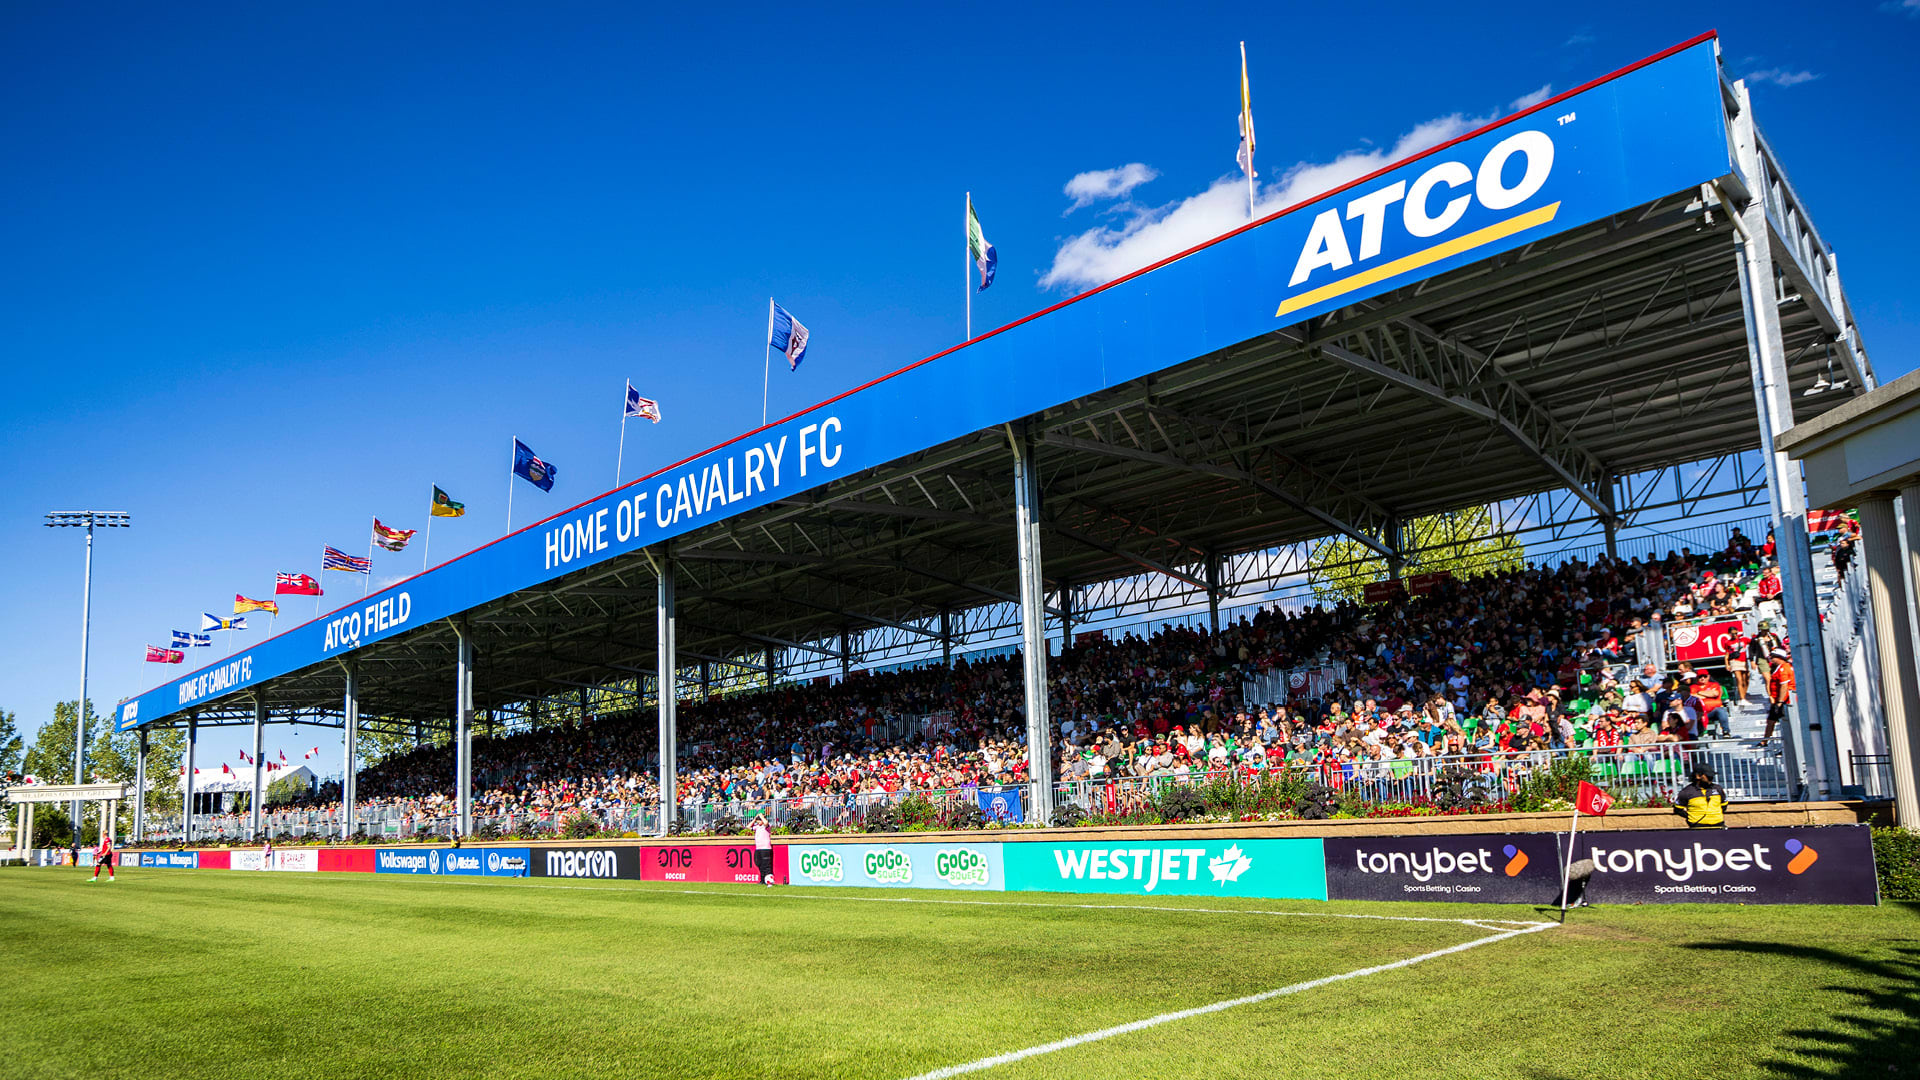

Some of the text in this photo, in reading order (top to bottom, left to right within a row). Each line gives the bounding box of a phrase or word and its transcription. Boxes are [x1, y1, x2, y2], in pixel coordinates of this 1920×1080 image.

[1287, 130, 1554, 288] ATCO
[545, 416, 842, 570] HOME OF CAVALRY FC
[323, 592, 411, 652] ATCO FIELD
[179, 655, 252, 705] HOME OF CAVALRY FC
[122, 701, 139, 722] ATCO
[379, 851, 427, 870] Volkswagen
[456, 856, 480, 869] Allstate
[547, 850, 618, 878] macron
[658, 849, 692, 868] one
[801, 850, 835, 874] GoGo
[865, 850, 902, 875] GoGo
[937, 850, 978, 876] GoGo
[1053, 849, 1206, 892] WESTJET
[1356, 847, 1493, 882] tonybet
[1591, 842, 1772, 882] tonybet
[735, 873, 759, 881] SOCCER
[1426, 885, 1451, 893] Betting
[1655, 885, 1756, 894] Sports Betting Casino
